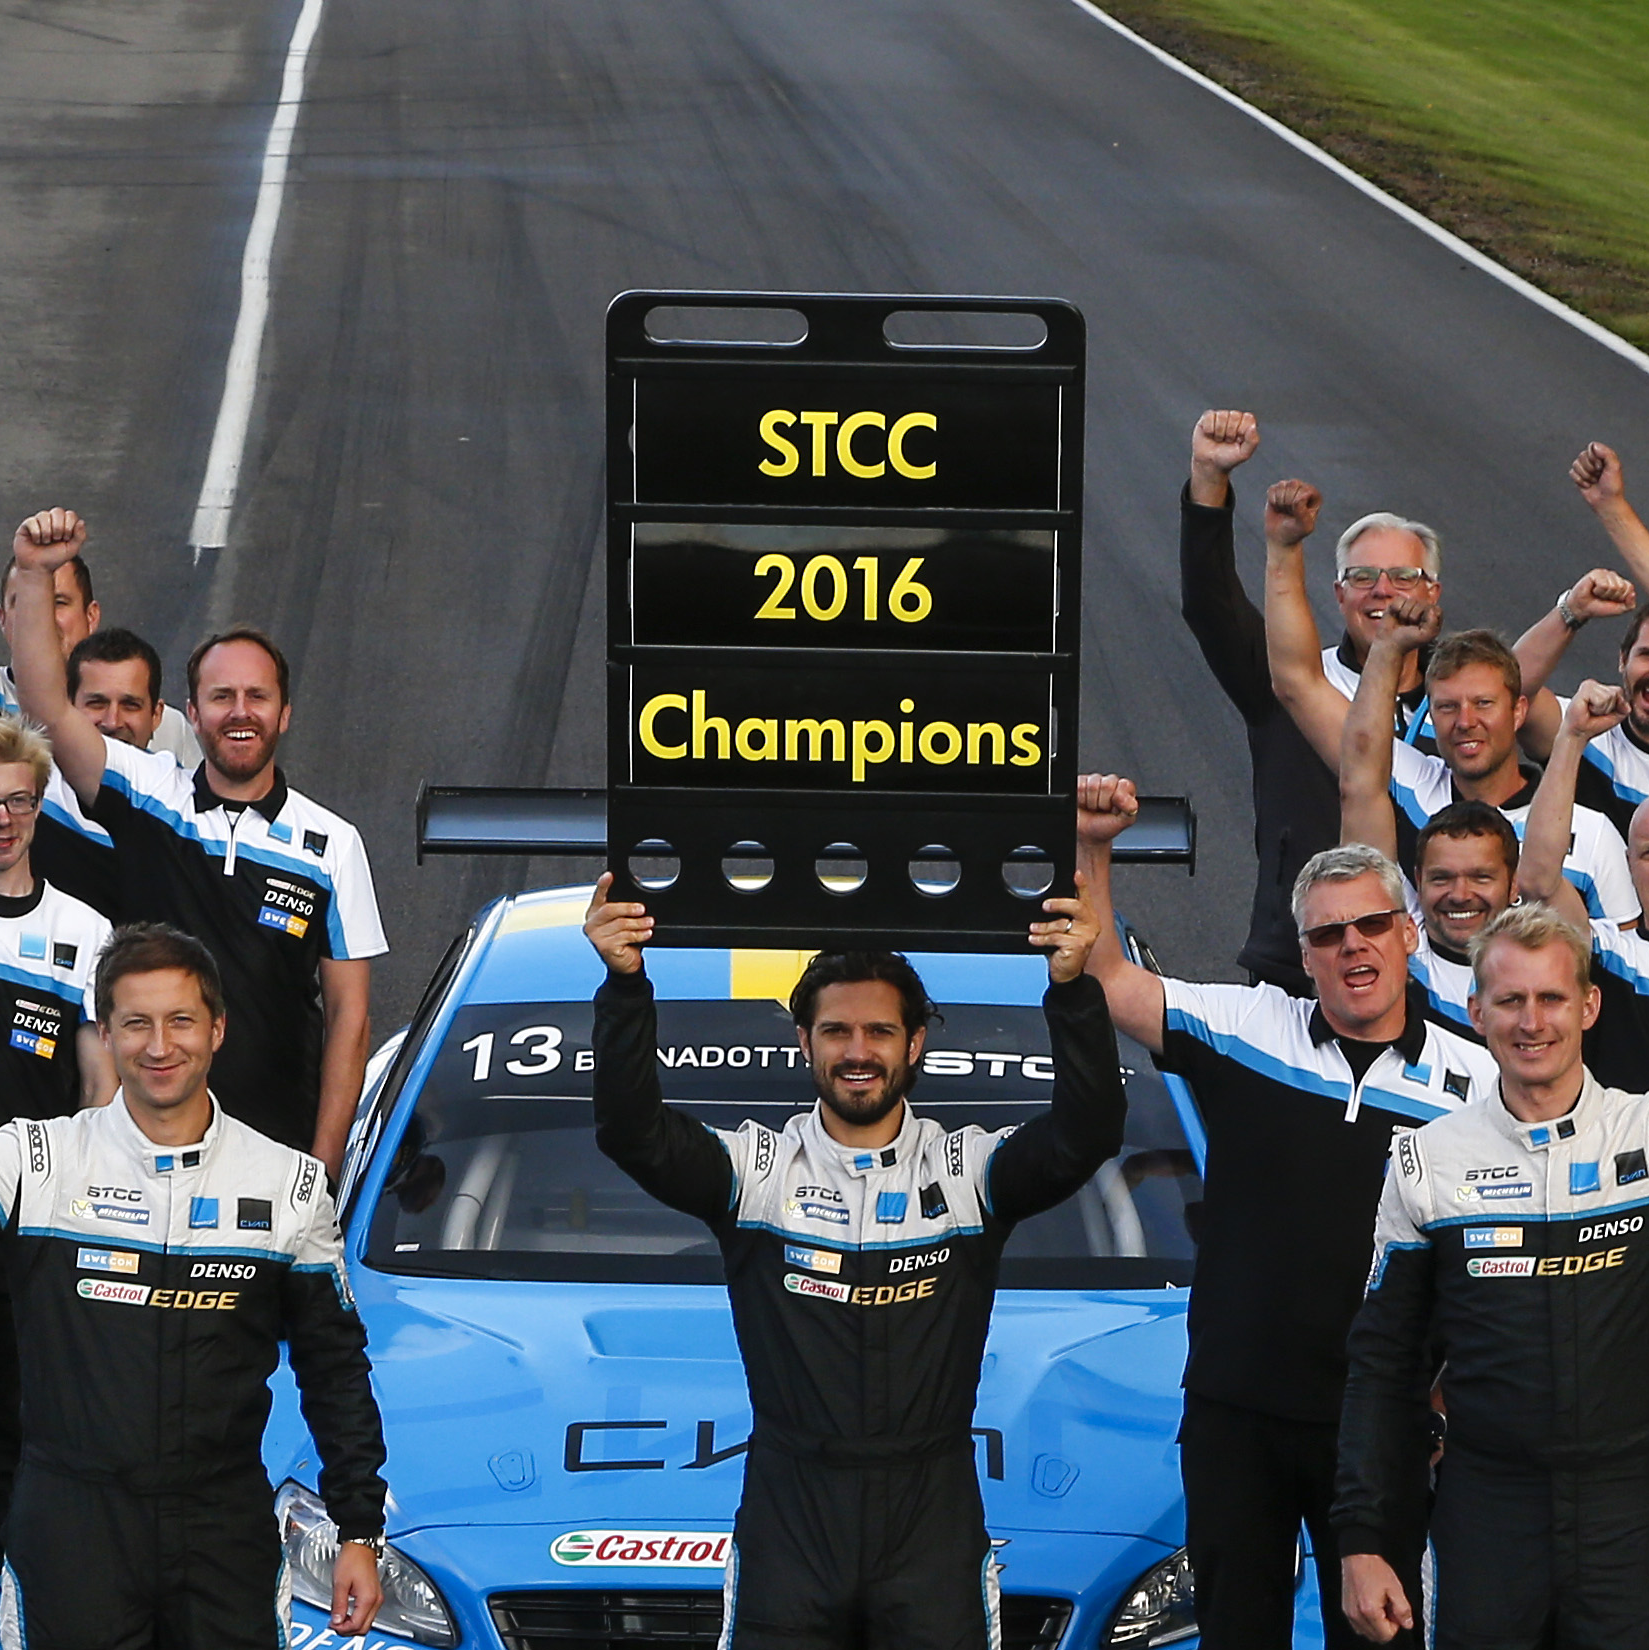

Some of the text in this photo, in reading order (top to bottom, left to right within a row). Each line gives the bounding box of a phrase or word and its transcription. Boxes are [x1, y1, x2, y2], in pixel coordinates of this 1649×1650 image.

[757, 409, 938, 480] STCC
[753, 553, 933, 623] 2016
[638, 689, 1042, 783] Champions
[264, 890, 314, 916] DENSO
[462, 1025, 811, 1082] 13 BNADOTT
[923, 1050, 1056, 1080] STC
[30, 1123, 45, 1173] sparco
[1465, 1165, 1520, 1182] STCC
[87, 1186, 143, 1203] STCC
[1481, 1184, 1532, 1198] MICHELIN
[97, 1207, 150, 1222] MICHELIN
[1578, 1216, 1644, 1243] DENSO
[190, 1263, 257, 1281] DENSO
[889, 1247, 951, 1274] DENSO
[1481, 1247, 1629, 1276] Castrol EDGE
[92, 1283, 240, 1311] Castrol EDGE
[799, 1277, 939, 1306] Castrol EDGE
[595, 1533, 726, 1564] Castrol
